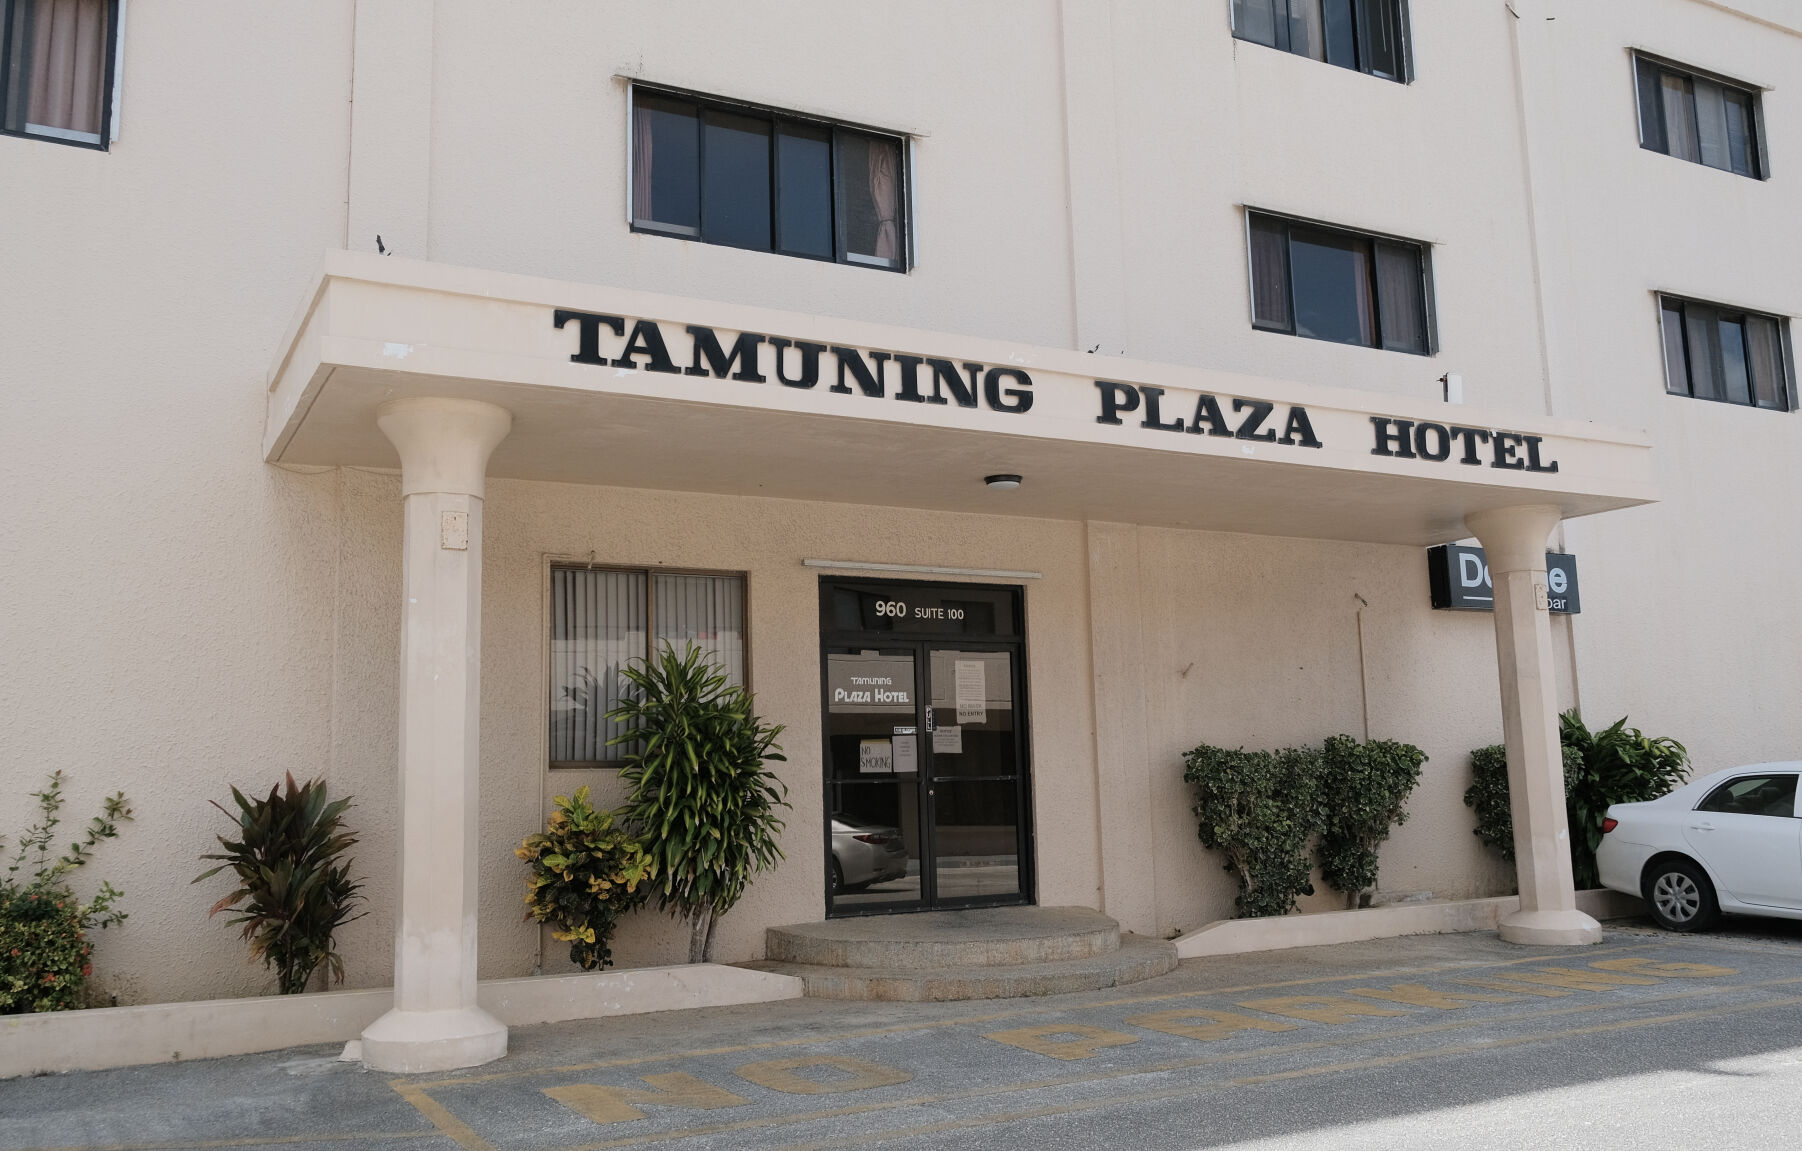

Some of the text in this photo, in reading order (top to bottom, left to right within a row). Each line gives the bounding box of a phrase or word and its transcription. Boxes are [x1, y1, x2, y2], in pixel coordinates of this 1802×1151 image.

[553, 309, 1559, 473] TAMUNING PLAZA HOTEL
[875, 601, 964, 620] 960 SUITE 100
[834, 688, 909, 702] PLAZA HOTEL
[861, 746, 871, 756] NO
[860, 757, 891, 769] SMOKING
[541, 957, 1742, 1125] NO PARKING
